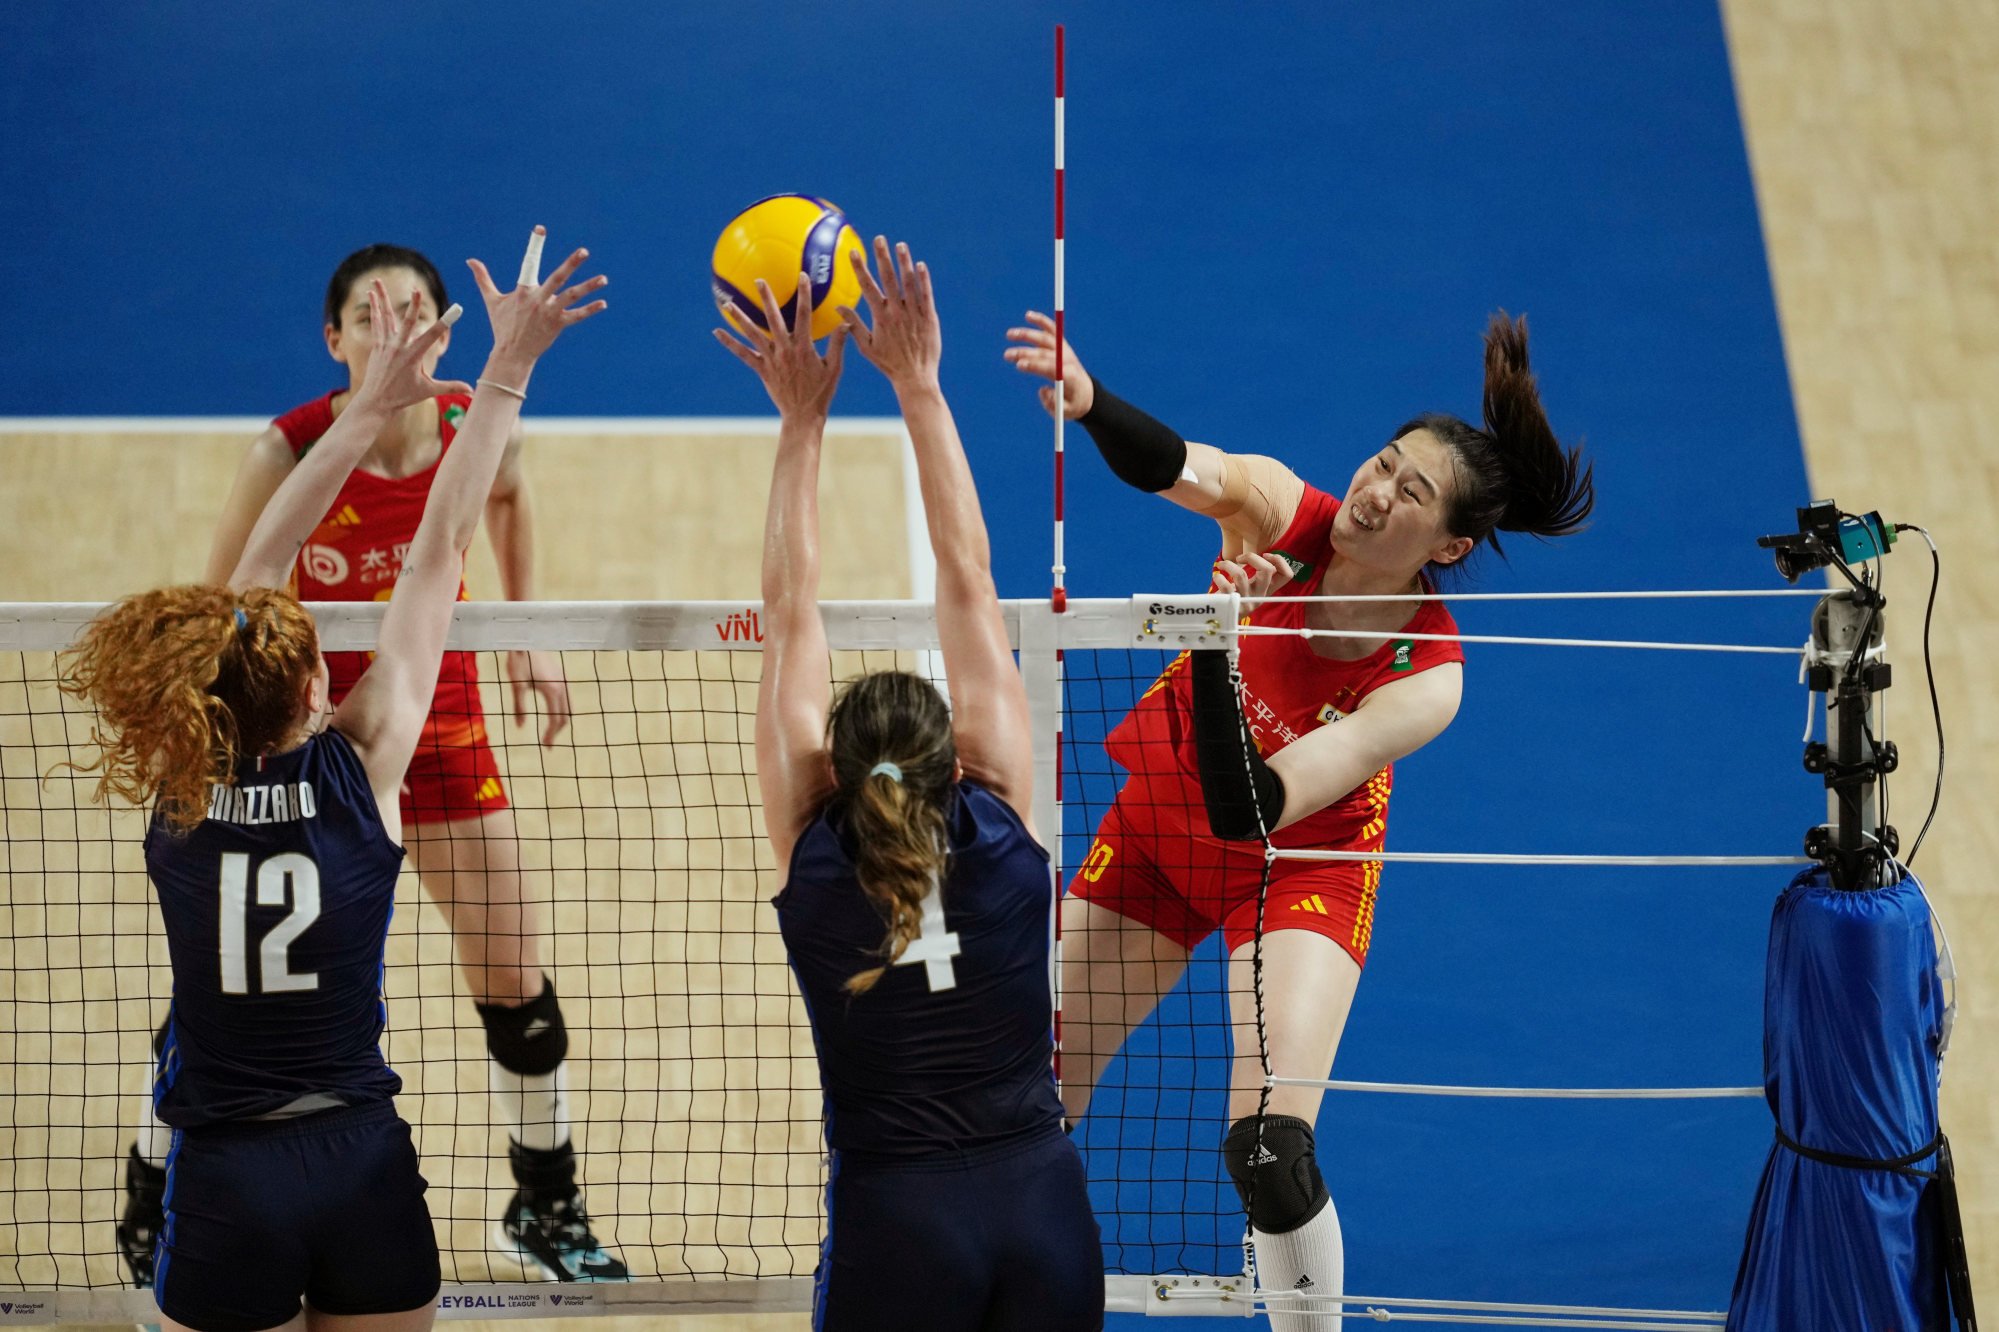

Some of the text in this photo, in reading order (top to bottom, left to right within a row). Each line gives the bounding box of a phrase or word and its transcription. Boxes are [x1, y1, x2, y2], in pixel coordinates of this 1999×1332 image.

[360, 543, 411, 571] 太平
[1164, 605, 1216, 616] Senoh
[1324, 709, 1344, 723] CH
[219, 852, 321, 994] 12
[890, 832, 961, 992] 4
